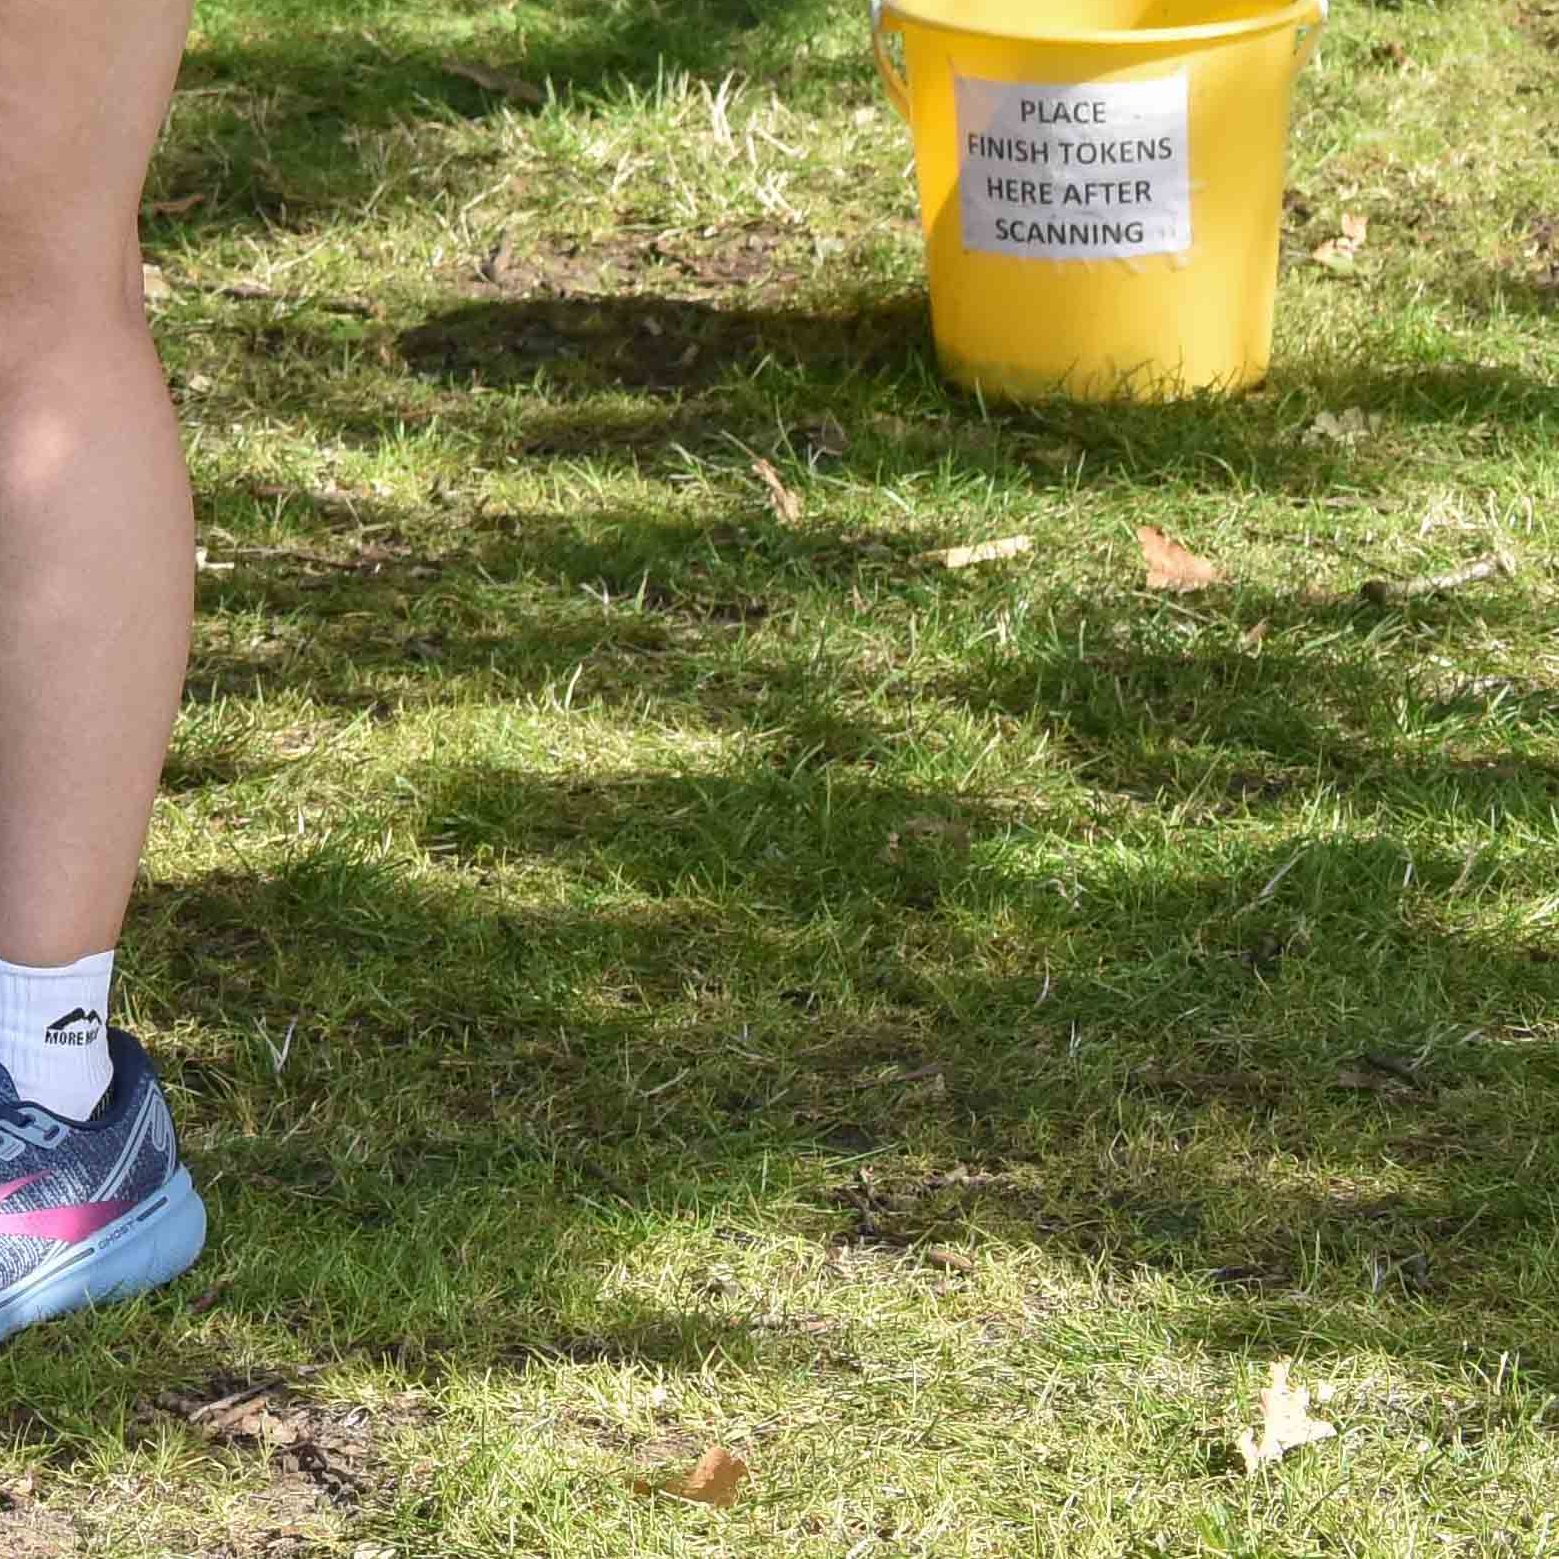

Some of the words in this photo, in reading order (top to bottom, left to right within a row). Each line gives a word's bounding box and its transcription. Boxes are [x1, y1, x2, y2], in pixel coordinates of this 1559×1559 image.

[1020, 100, 1106, 124] PLACE
[968, 133, 1049, 164] FINISH
[1058, 137, 1172, 165] TOKENS
[987, 177, 1053, 205] HERE
[1063, 180, 1152, 205] AFTER
[995, 218, 1144, 245] SCANNING
[44, 1030, 84, 1046] MORE
